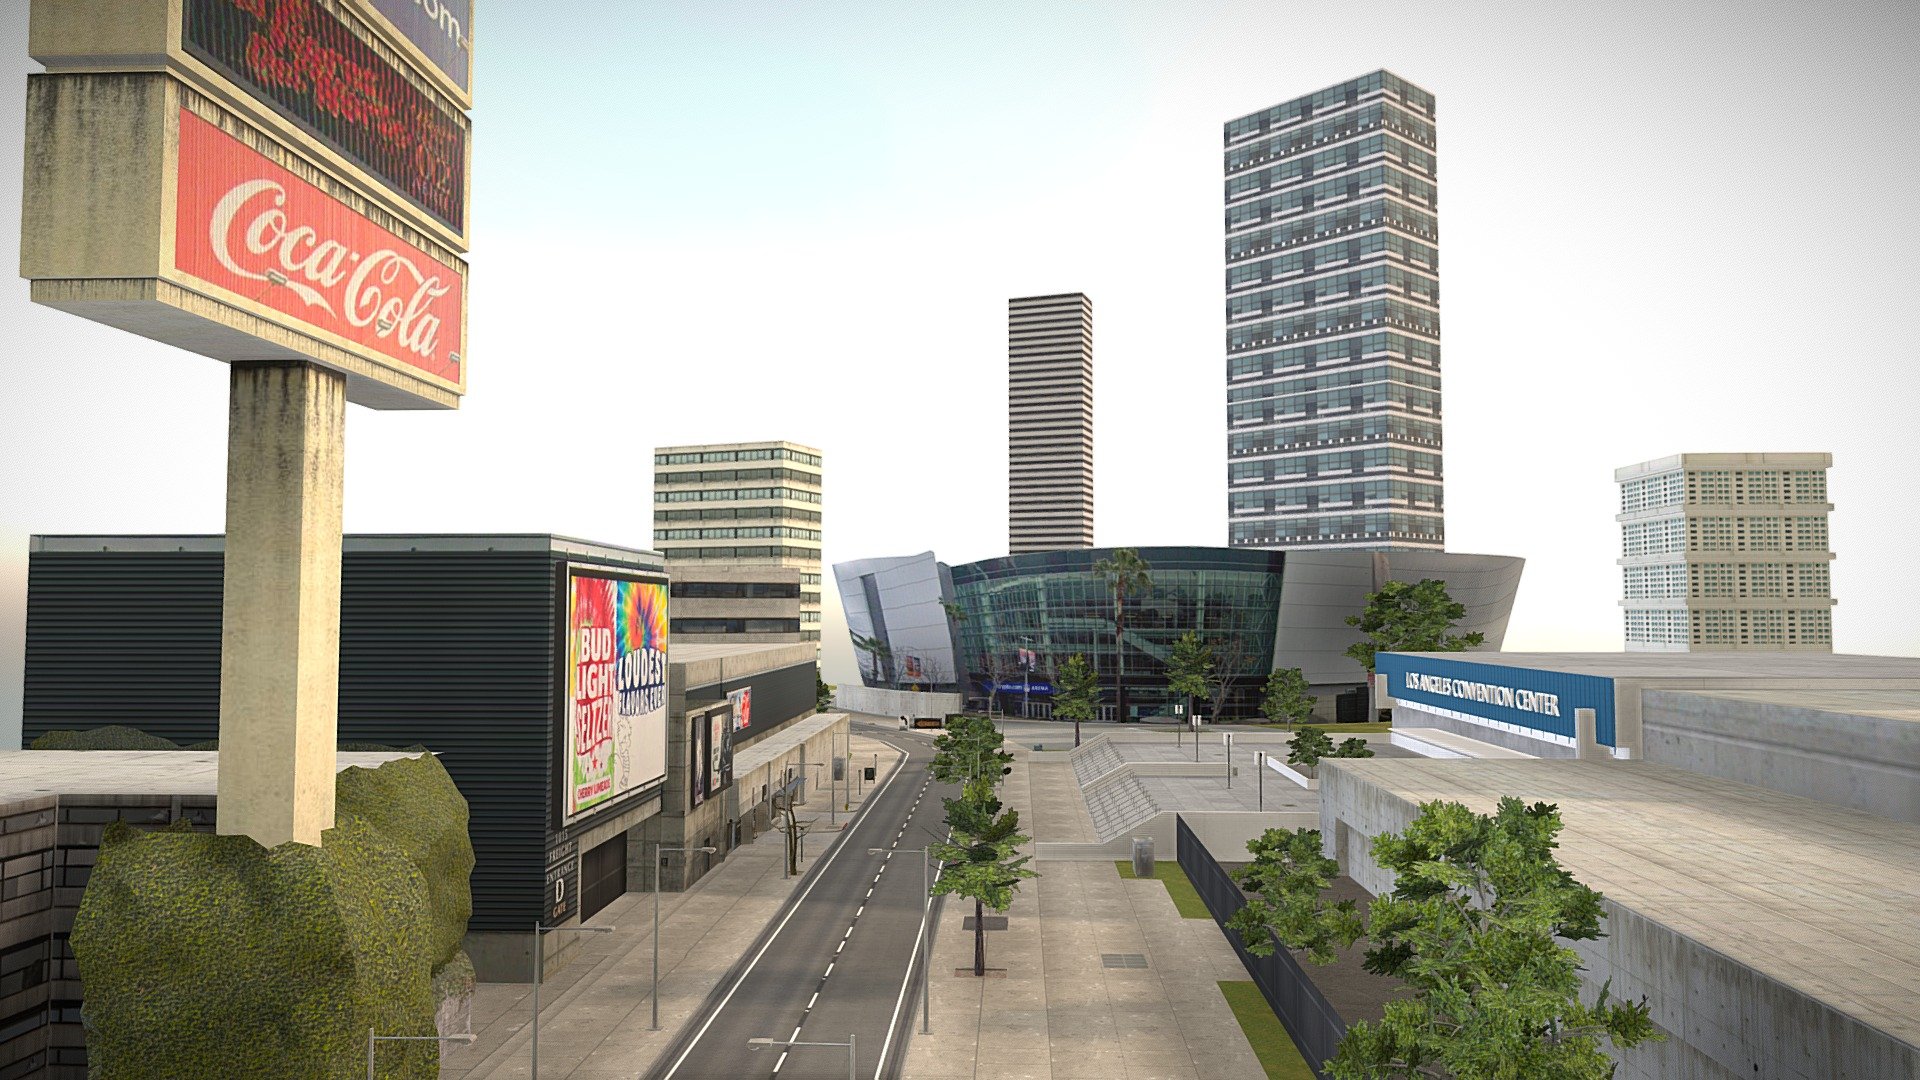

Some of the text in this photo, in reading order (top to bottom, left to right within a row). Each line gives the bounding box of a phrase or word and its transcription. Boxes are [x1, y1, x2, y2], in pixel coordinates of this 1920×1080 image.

[209, 179, 451, 357] Coca-Cola
[581, 628, 611, 662] BUD
[577, 663, 615, 699] LIGHT
[618, 648, 666, 690] LOUDEST
[1406, 671, 1560, 716] LOS ANGELES CONVENTION CENTER
[577, 697, 612, 753] SELTZER
[549, 841, 573, 863] FREIGHT
[546, 860, 574, 885] ENTRANCE
[556, 877, 565, 903] D
[552, 901, 567, 918] GATE
